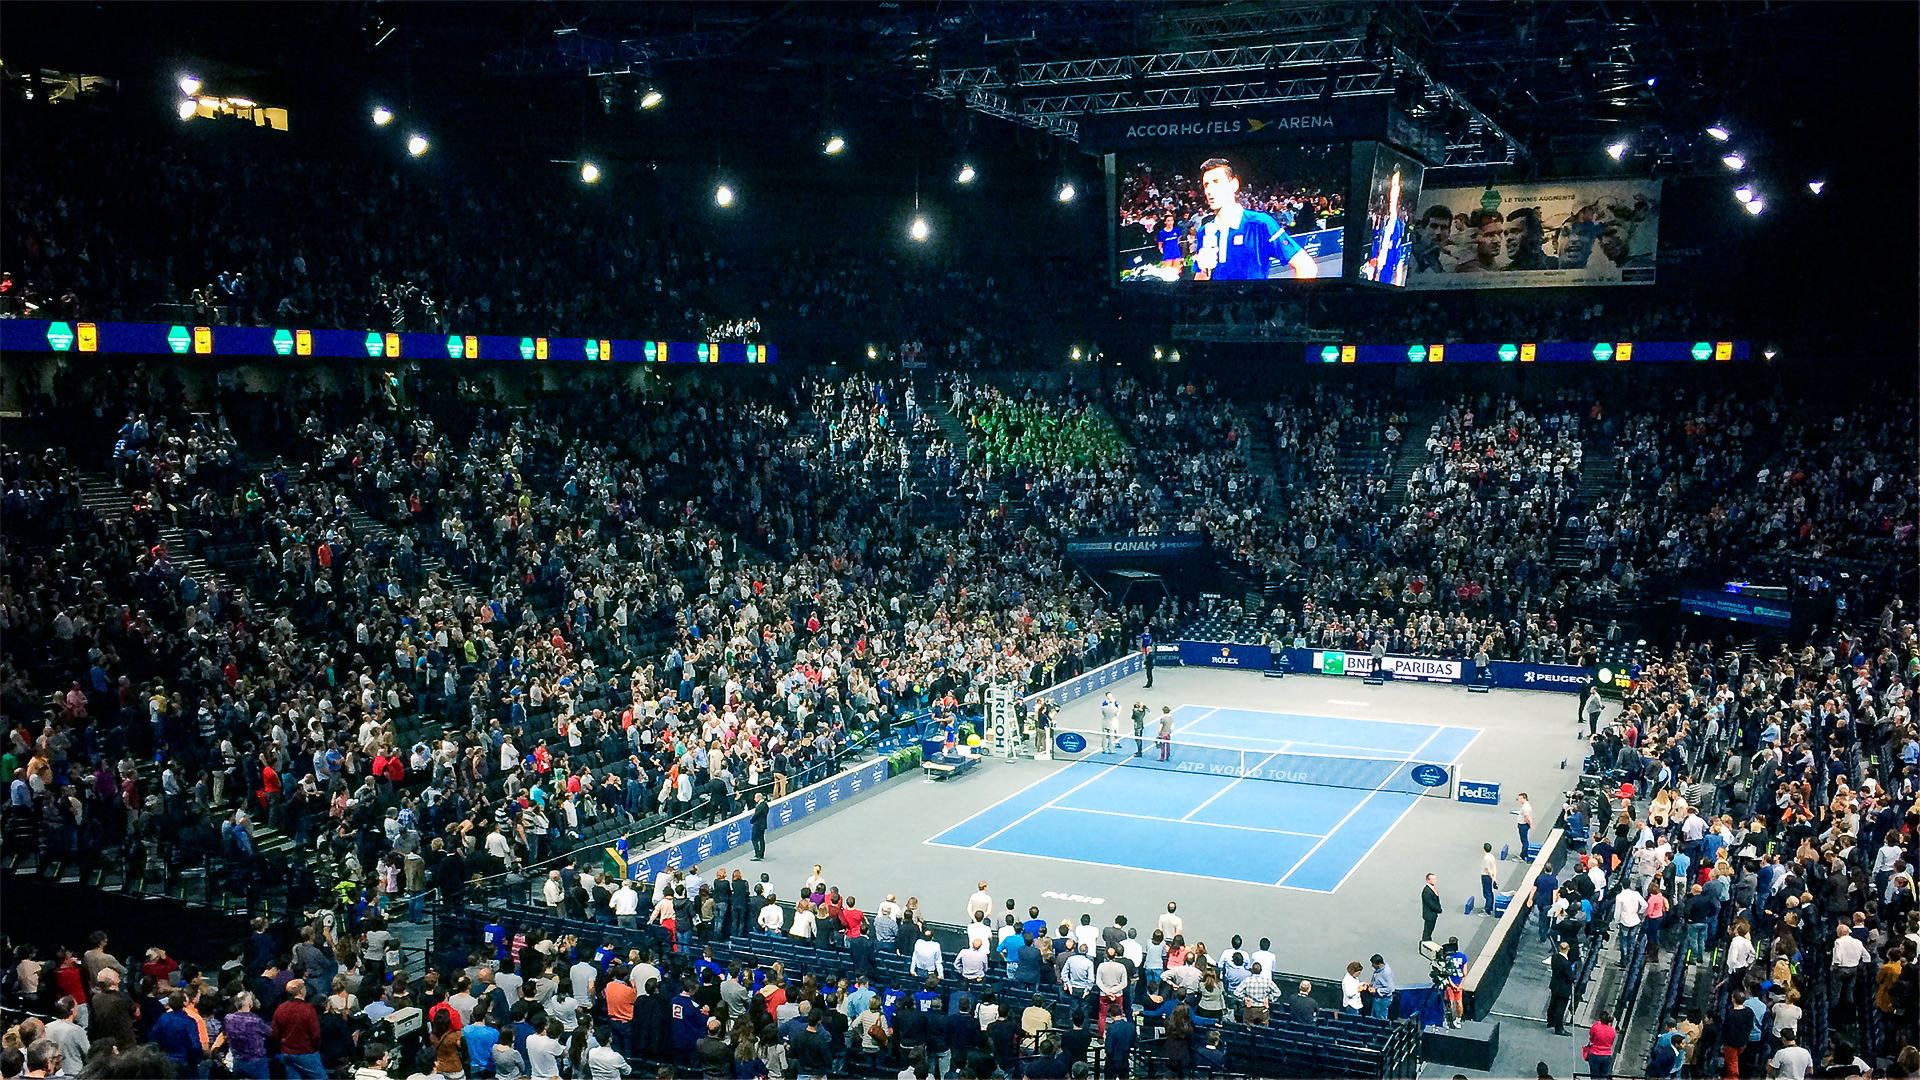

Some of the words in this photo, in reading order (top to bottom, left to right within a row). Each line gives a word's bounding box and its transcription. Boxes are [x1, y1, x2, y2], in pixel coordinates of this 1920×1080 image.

[1126, 119, 1241, 138] ACCORHOTELS
[1278, 115, 1334, 130] ARENA
[1113, 541, 1158, 552] CANAL+
[1211, 656, 1239, 665] ROLEX
[1347, 657, 1374, 669] BNP
[1395, 660, 1453, 675] PARIBAS
[1536, 673, 1594, 684] PEUGEO
[995, 698, 1005, 748] RICOH
[1176, 760, 1205, 772] ATP
[1209, 763, 1263, 778] WORLD
[1268, 769, 1308, 782] TOUR
[1460, 785, 1497, 800] FedEx
[1040, 890, 1106, 905] PARIS
[673, 1004, 683, 1019] 2
